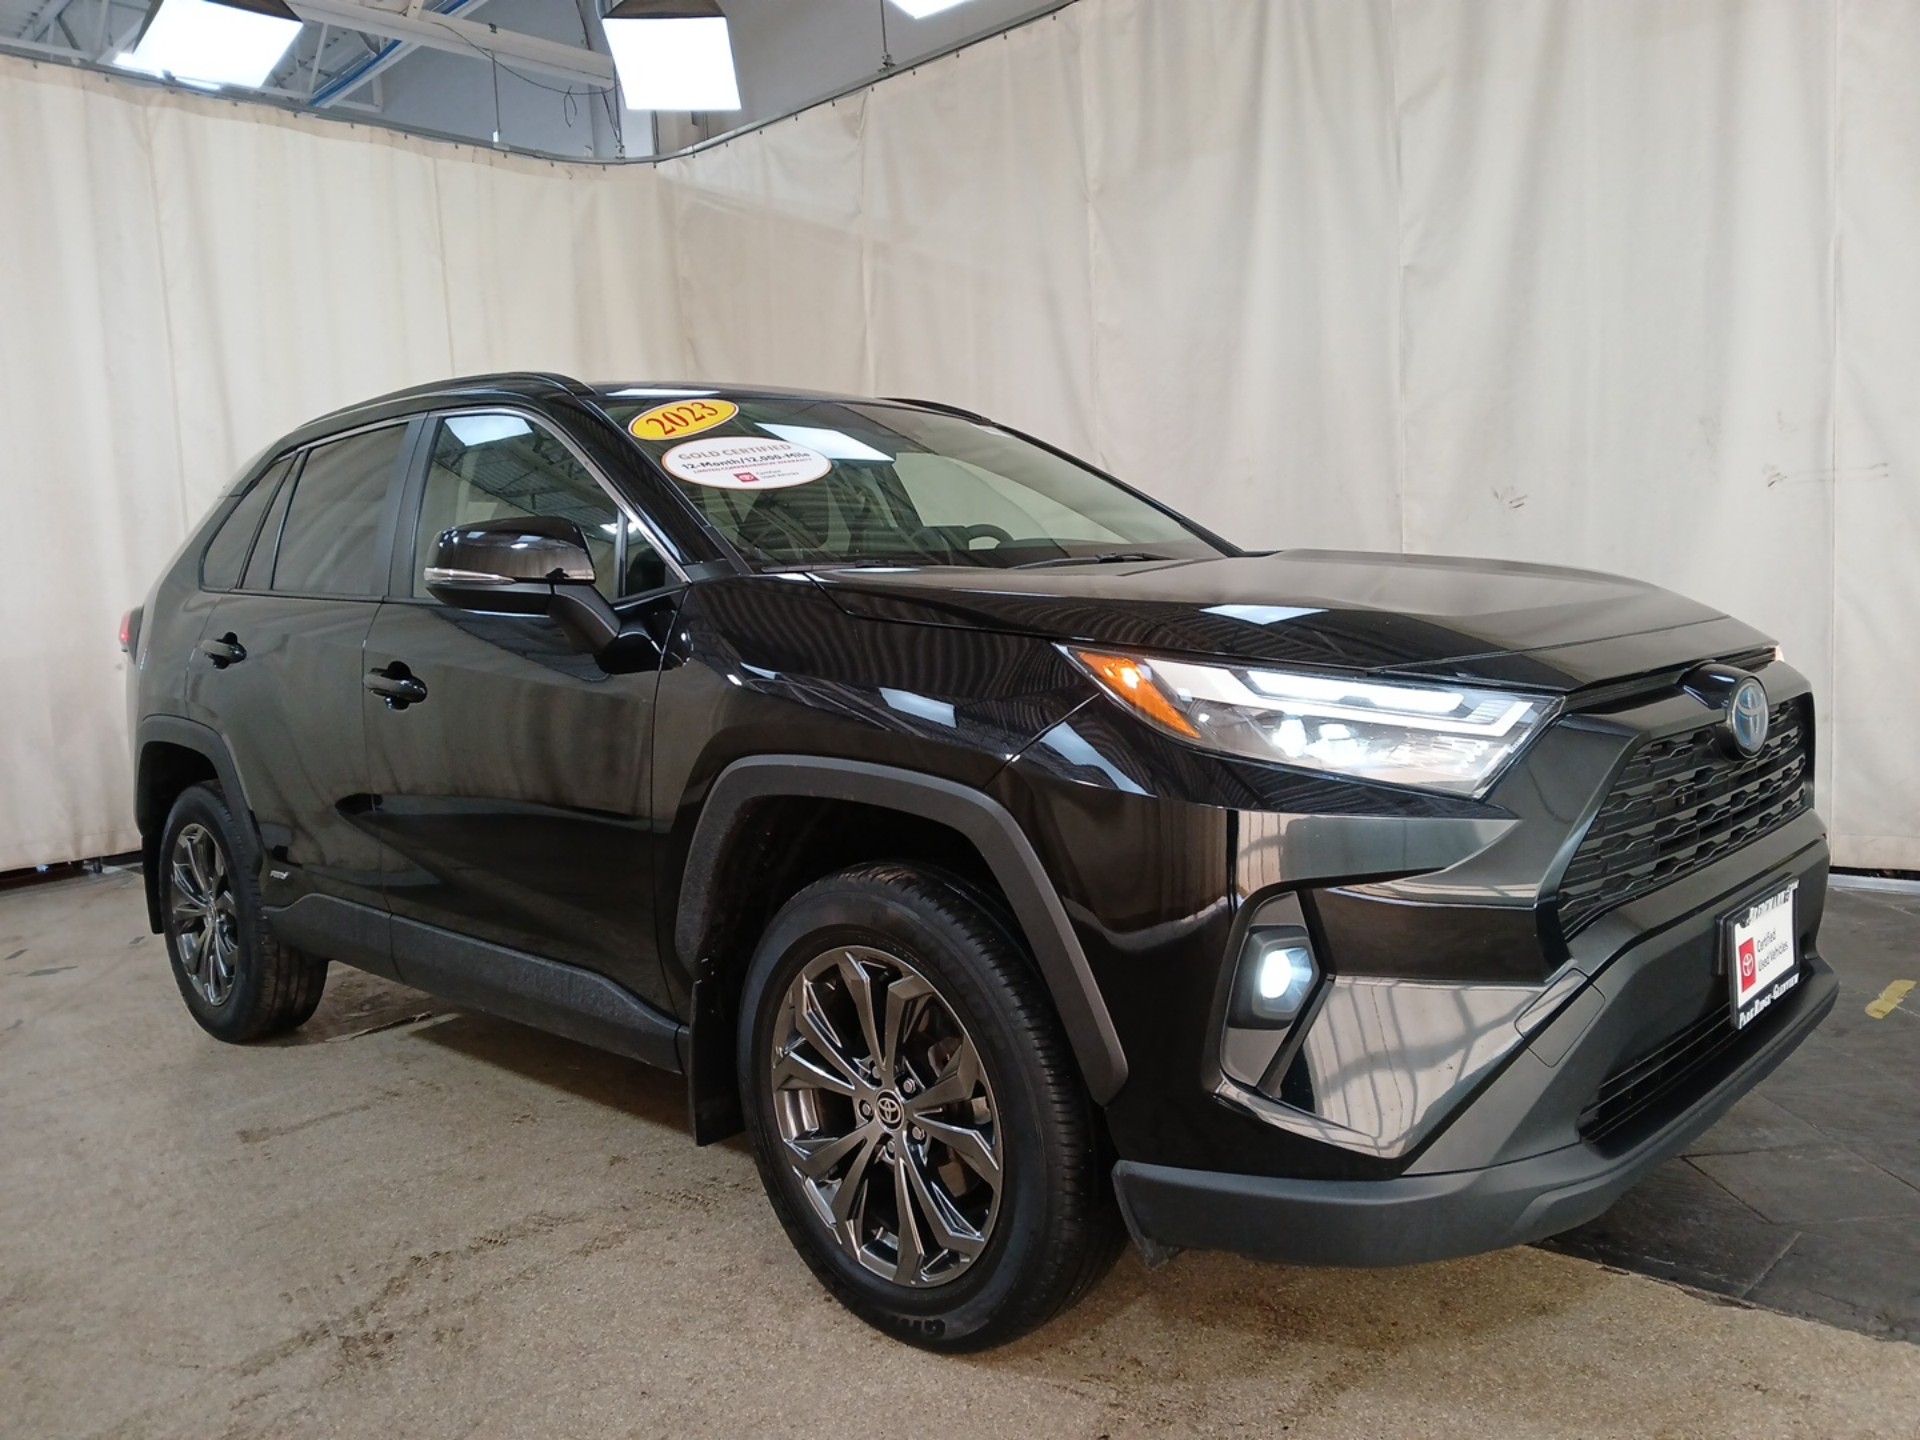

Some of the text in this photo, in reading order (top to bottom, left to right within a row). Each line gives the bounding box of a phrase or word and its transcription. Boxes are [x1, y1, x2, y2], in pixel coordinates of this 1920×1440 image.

[646, 402, 718, 435] 2023
[678, 444, 792, 460] GOLD CERTIFIED
[1757, 928, 1776, 952] Certified
[1758, 941, 1788, 971] Used Vehicles
